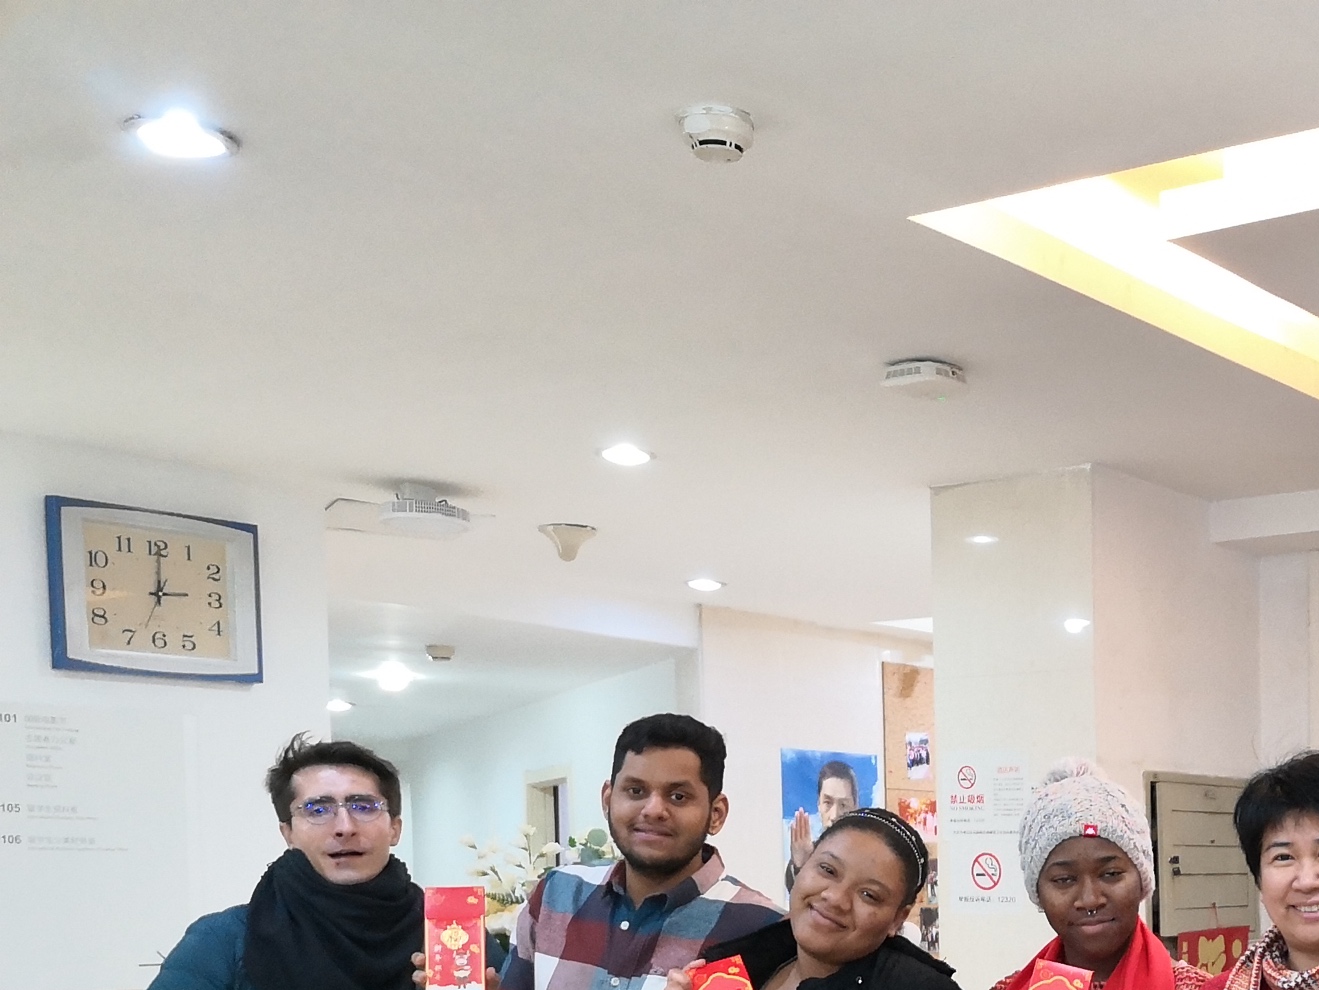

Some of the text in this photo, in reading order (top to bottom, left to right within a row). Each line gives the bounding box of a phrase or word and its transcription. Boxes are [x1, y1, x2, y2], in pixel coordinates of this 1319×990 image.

[116, 535, 133, 553] 11
[147, 540, 169, 558] 12
[88, 550, 108, 568] 10
[185, 545, 192, 561] 1
[206, 564, 221, 582] 2
[90, 579, 107, 596] 9
[207, 592, 223, 609] 3
[91, 607, 108, 625] 8
[122, 629, 137, 645] 7
[208, 620, 223, 637] 4
[151, 631, 167, 649] 6
[182, 634, 196, 651] 5
[950, 794, 985, 804] 禁止吸烟
[0, 803, 21, 813] 105
[1, 835, 22, 844] 106
